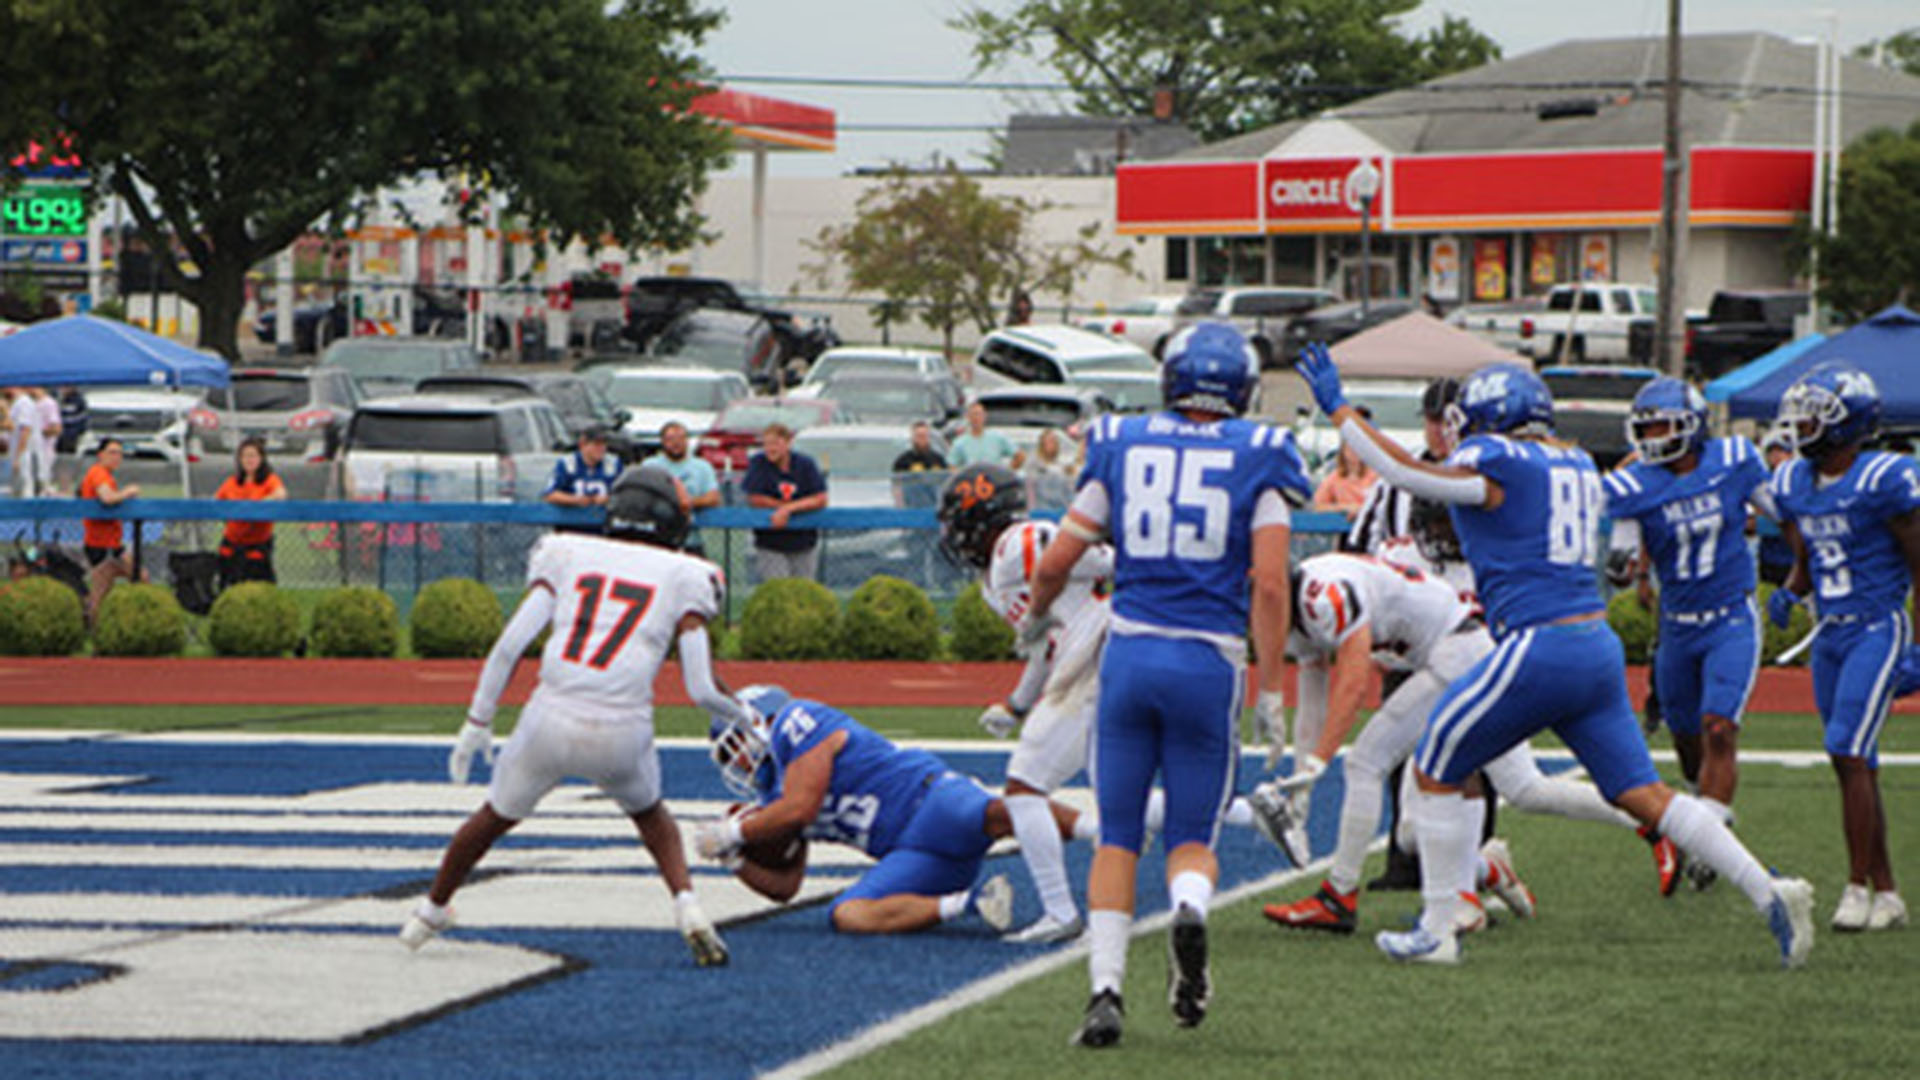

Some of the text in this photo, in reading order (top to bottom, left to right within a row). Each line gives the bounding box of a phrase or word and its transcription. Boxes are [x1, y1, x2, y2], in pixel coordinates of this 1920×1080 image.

[1271, 178, 1340, 206] CIRCLE
[953, 471, 995, 510] 26
[1122, 445, 1236, 561] 85
[1675, 512, 1723, 580] 17
[560, 571, 658, 672] 17
[781, 706, 819, 746] 26
